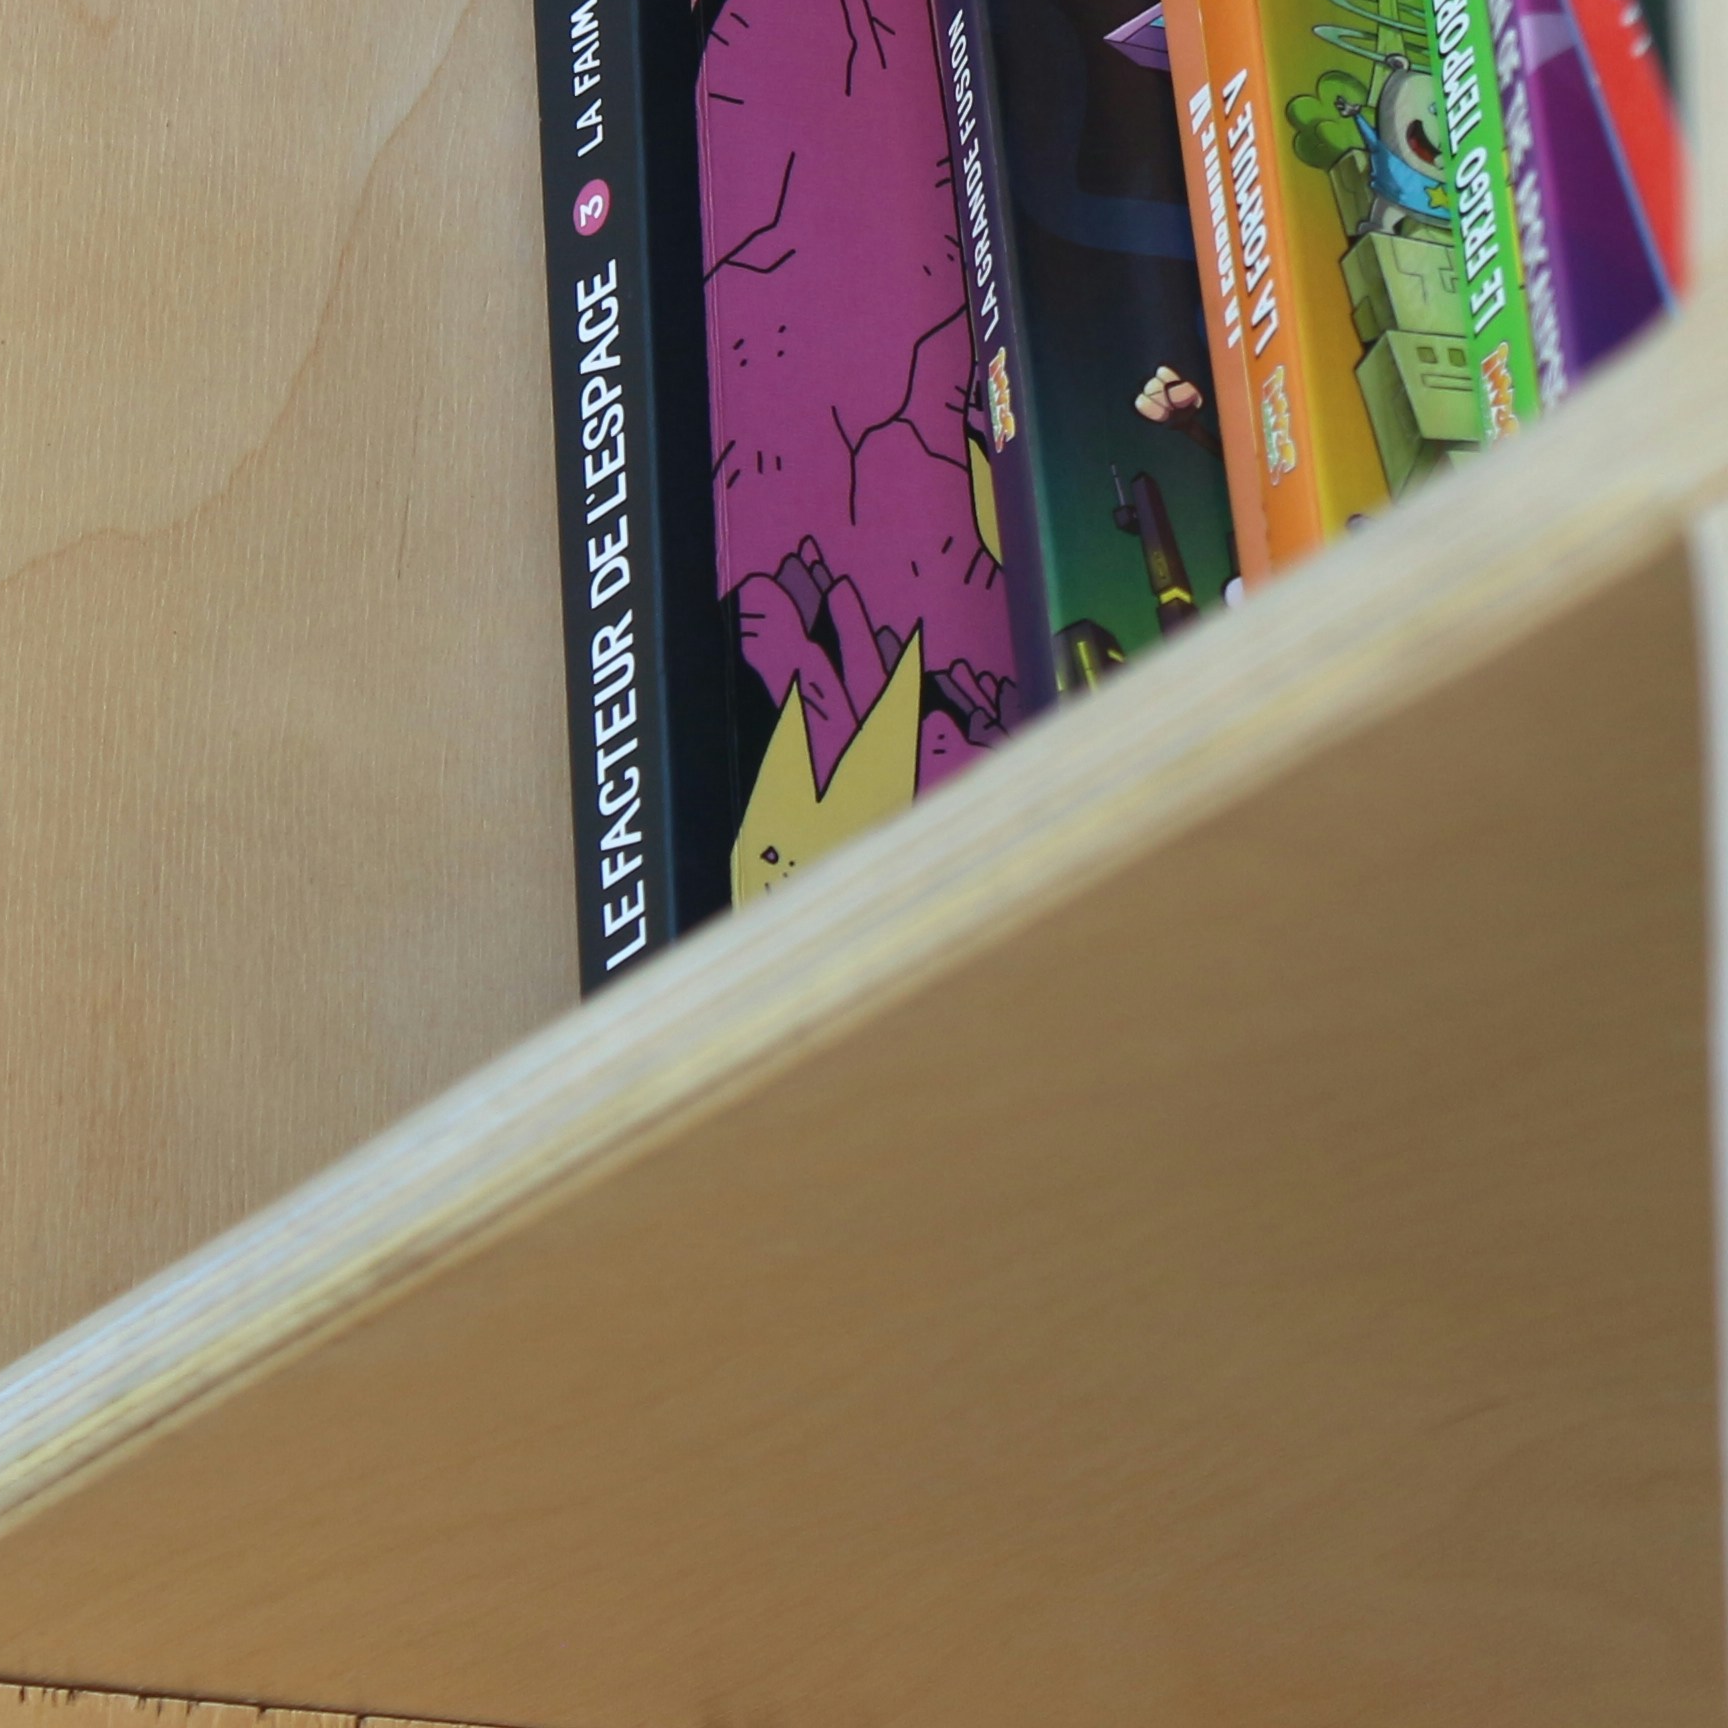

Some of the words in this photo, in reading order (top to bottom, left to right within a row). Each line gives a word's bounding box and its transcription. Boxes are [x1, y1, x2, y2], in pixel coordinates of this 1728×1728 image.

[949, 10, 977, 146] FUSION
[1222, 68, 1248, 118] V
[577, 99, 605, 158] LA
[578, 193, 607, 230] 3
[964, 138, 994, 289] GRANDE
[1228, 101, 1272, 294] FORMULE
[1456, 146, 1499, 285] FRIGO
[981, 282, 1001, 343] LA
[1251, 279, 1280, 357] LA
[1471, 267, 1506, 338] LE
[577, 259, 628, 526] L'ESPACE
[589, 515, 632, 610] DE
[592, 609, 644, 891] FACTEUR
[604, 880, 648, 972] LE
